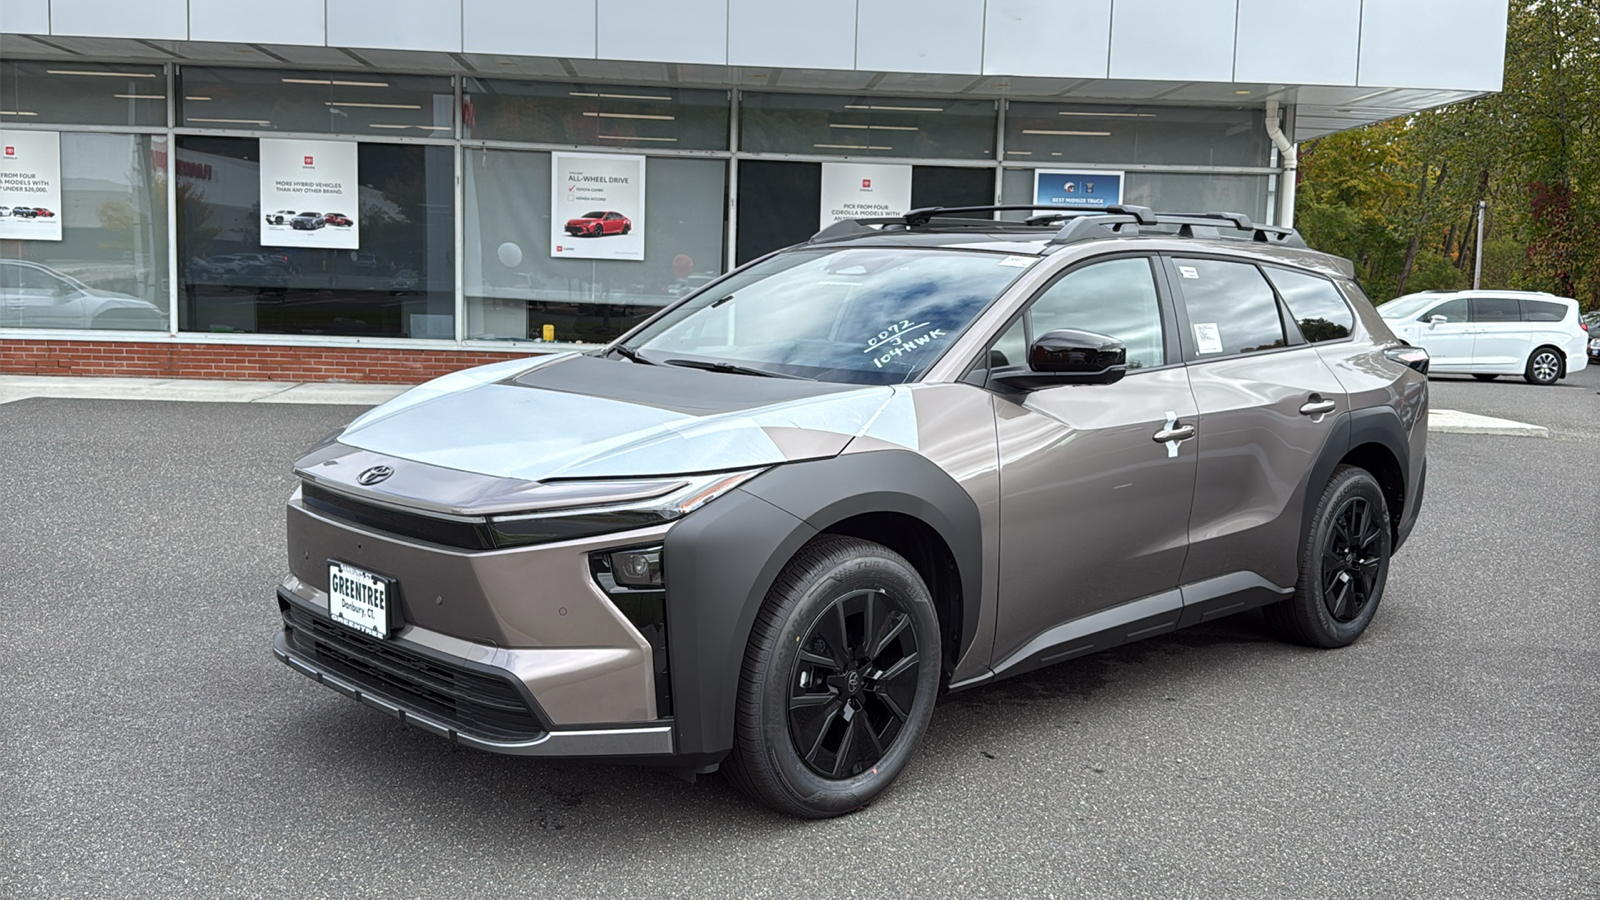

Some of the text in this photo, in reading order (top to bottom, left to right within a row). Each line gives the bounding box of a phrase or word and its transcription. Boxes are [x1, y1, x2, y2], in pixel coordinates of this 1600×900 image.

[568, 175, 608, 183] ALL-WHEEL
[867, 319, 915, 346] 0072
[873, 328, 946, 368] 104NWK
[332, 573, 385, 610] GREENTREE
